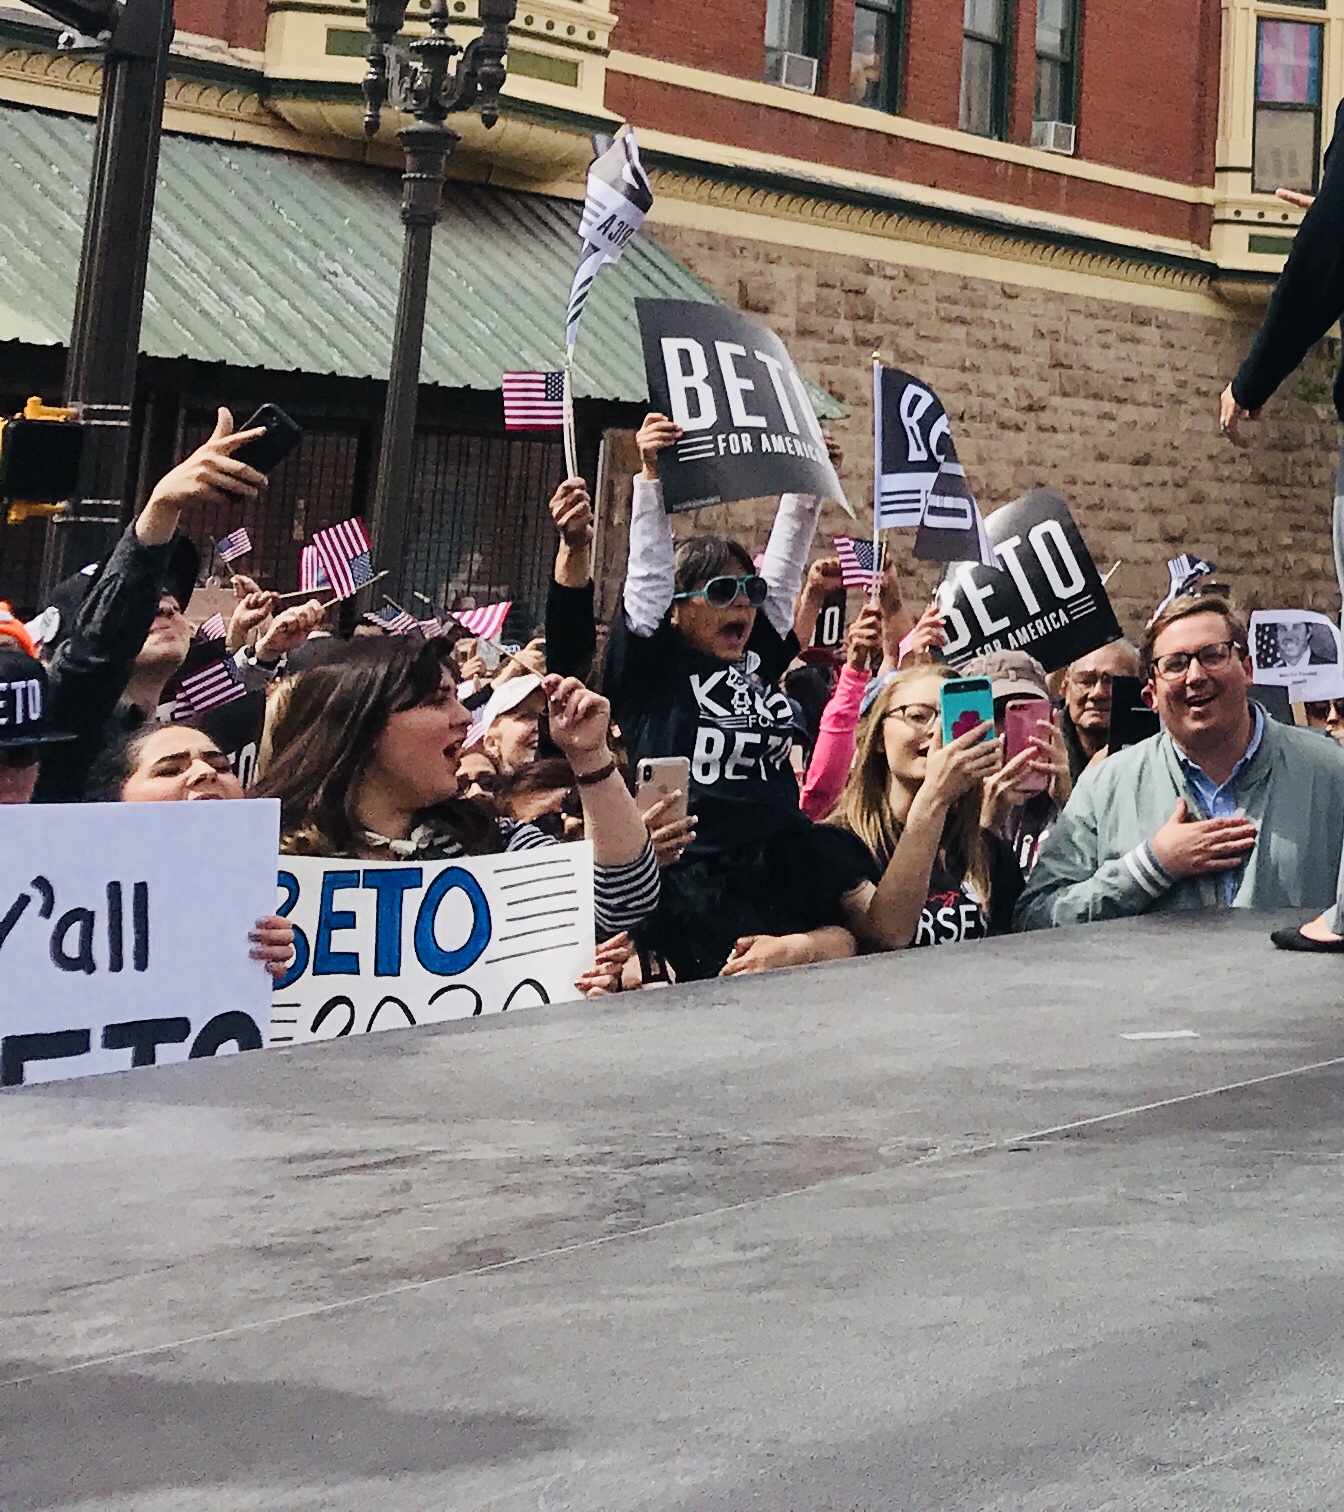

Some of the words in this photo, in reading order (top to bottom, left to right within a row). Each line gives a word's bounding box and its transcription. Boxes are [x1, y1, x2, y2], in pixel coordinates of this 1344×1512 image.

[717, 432, 753, 457] FOR
[1007, 608, 1070, 650] AMERICA
[0, 678, 42, 725] ETO
